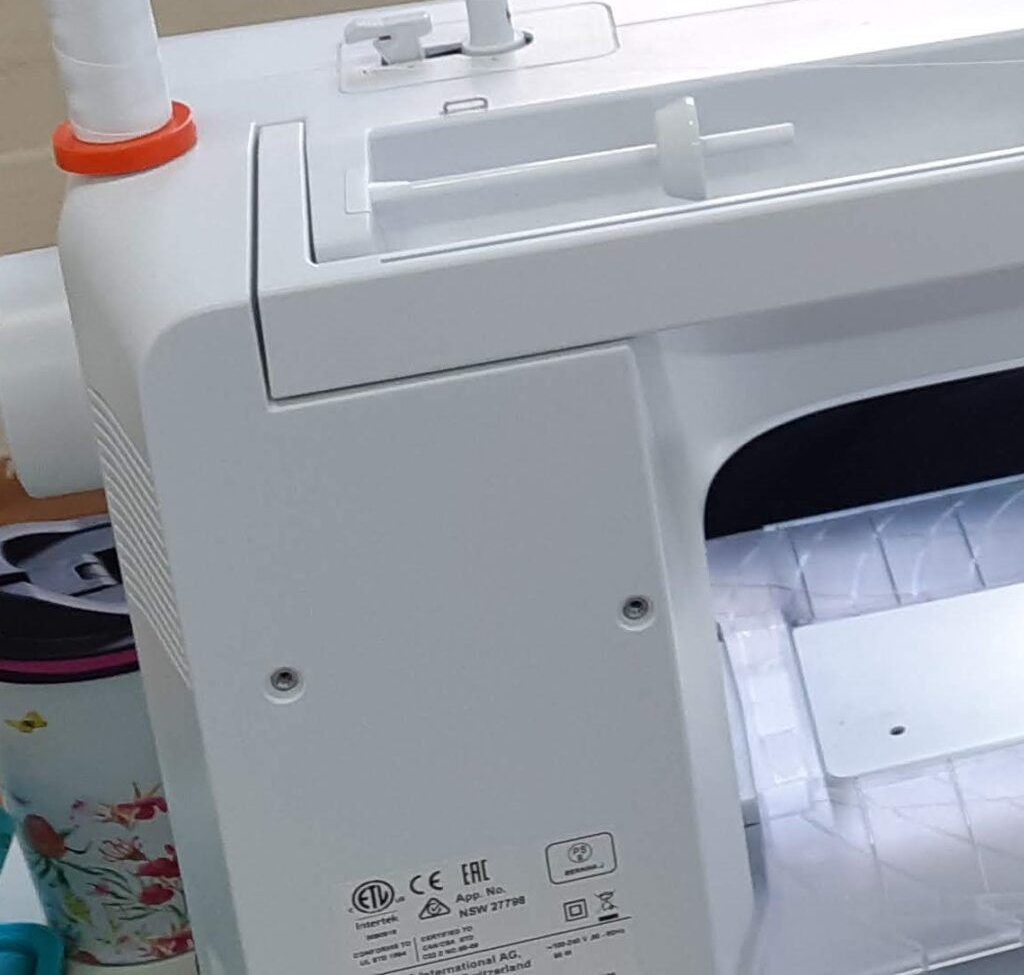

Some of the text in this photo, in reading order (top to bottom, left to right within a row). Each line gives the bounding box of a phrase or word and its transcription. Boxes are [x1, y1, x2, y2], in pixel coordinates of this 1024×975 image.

[461, 859, 490, 886] EAC
[409, 870, 444, 895] CE
[455, 892, 482, 904] App.
[459, 905, 488, 919] NSW
[355, 915, 399, 930] Intertek
[462, 959, 532, 975] itzerland
